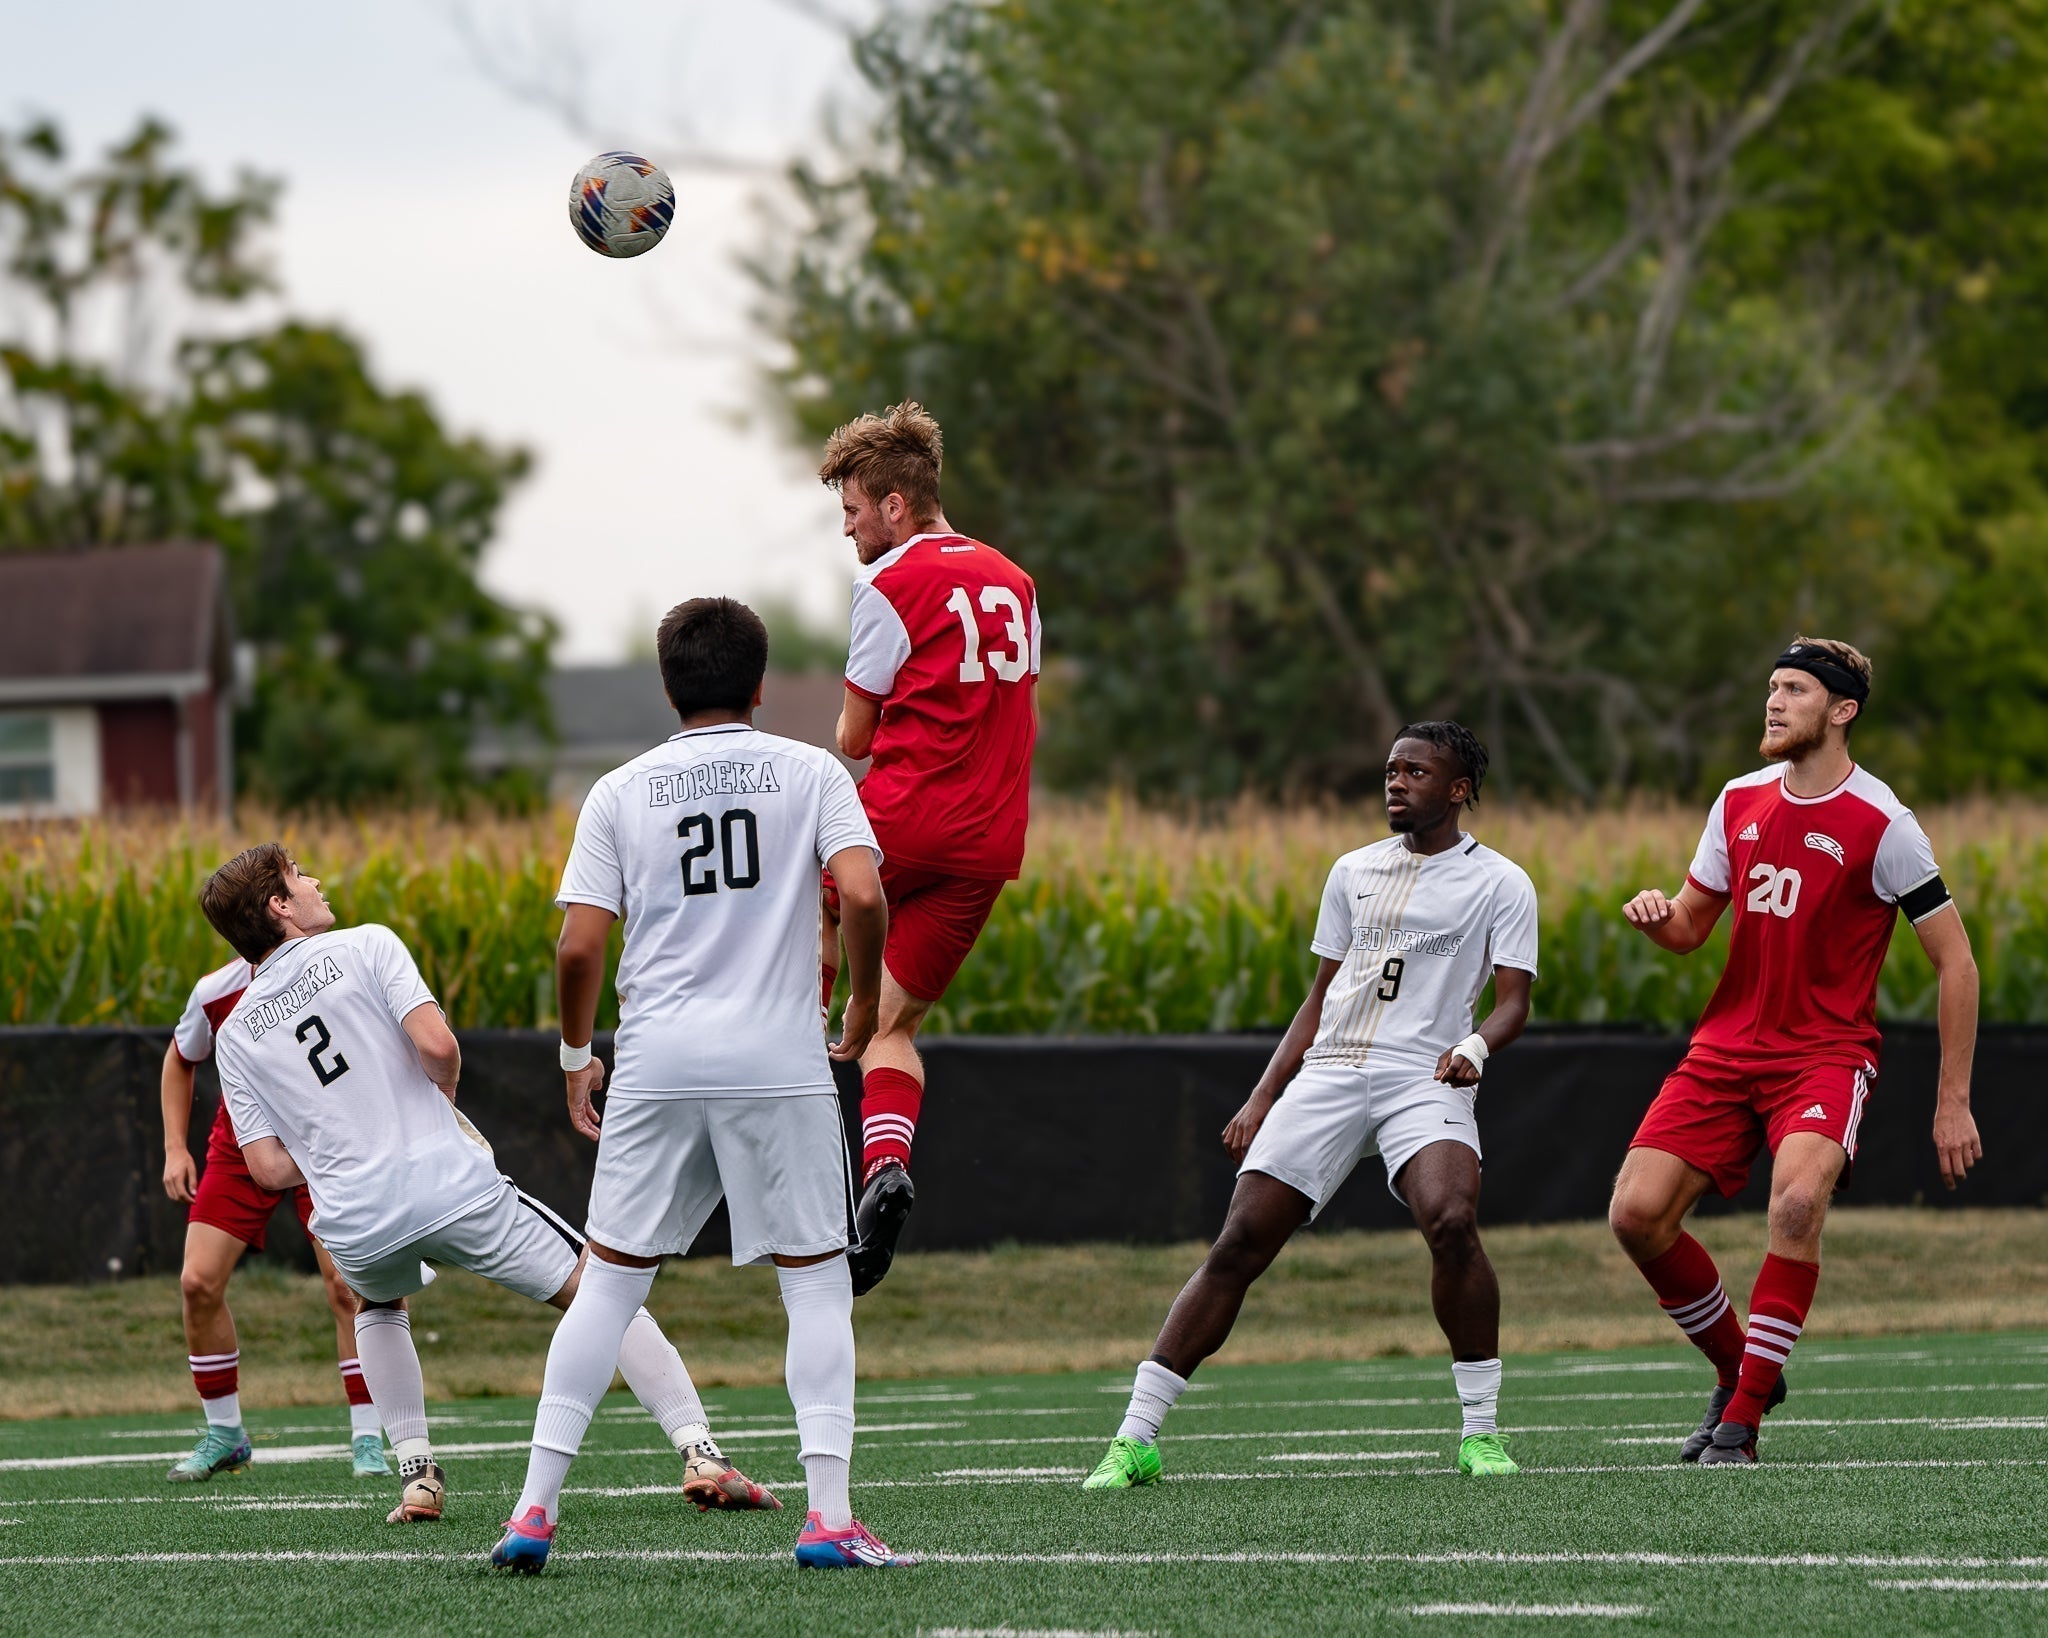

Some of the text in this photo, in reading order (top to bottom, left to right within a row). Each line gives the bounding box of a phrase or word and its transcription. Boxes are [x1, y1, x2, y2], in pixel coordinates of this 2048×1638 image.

[945, 586, 1029, 683] 13
[649, 760, 780, 807] EUREKA
[677, 808, 760, 897] 20
[1747, 863, 1802, 919] 20
[1352, 926, 1464, 958] ED DEVILS
[243, 955, 343, 1042] EUREKA
[1377, 957, 1405, 1001] 9
[295, 1014, 350, 1088] 2
